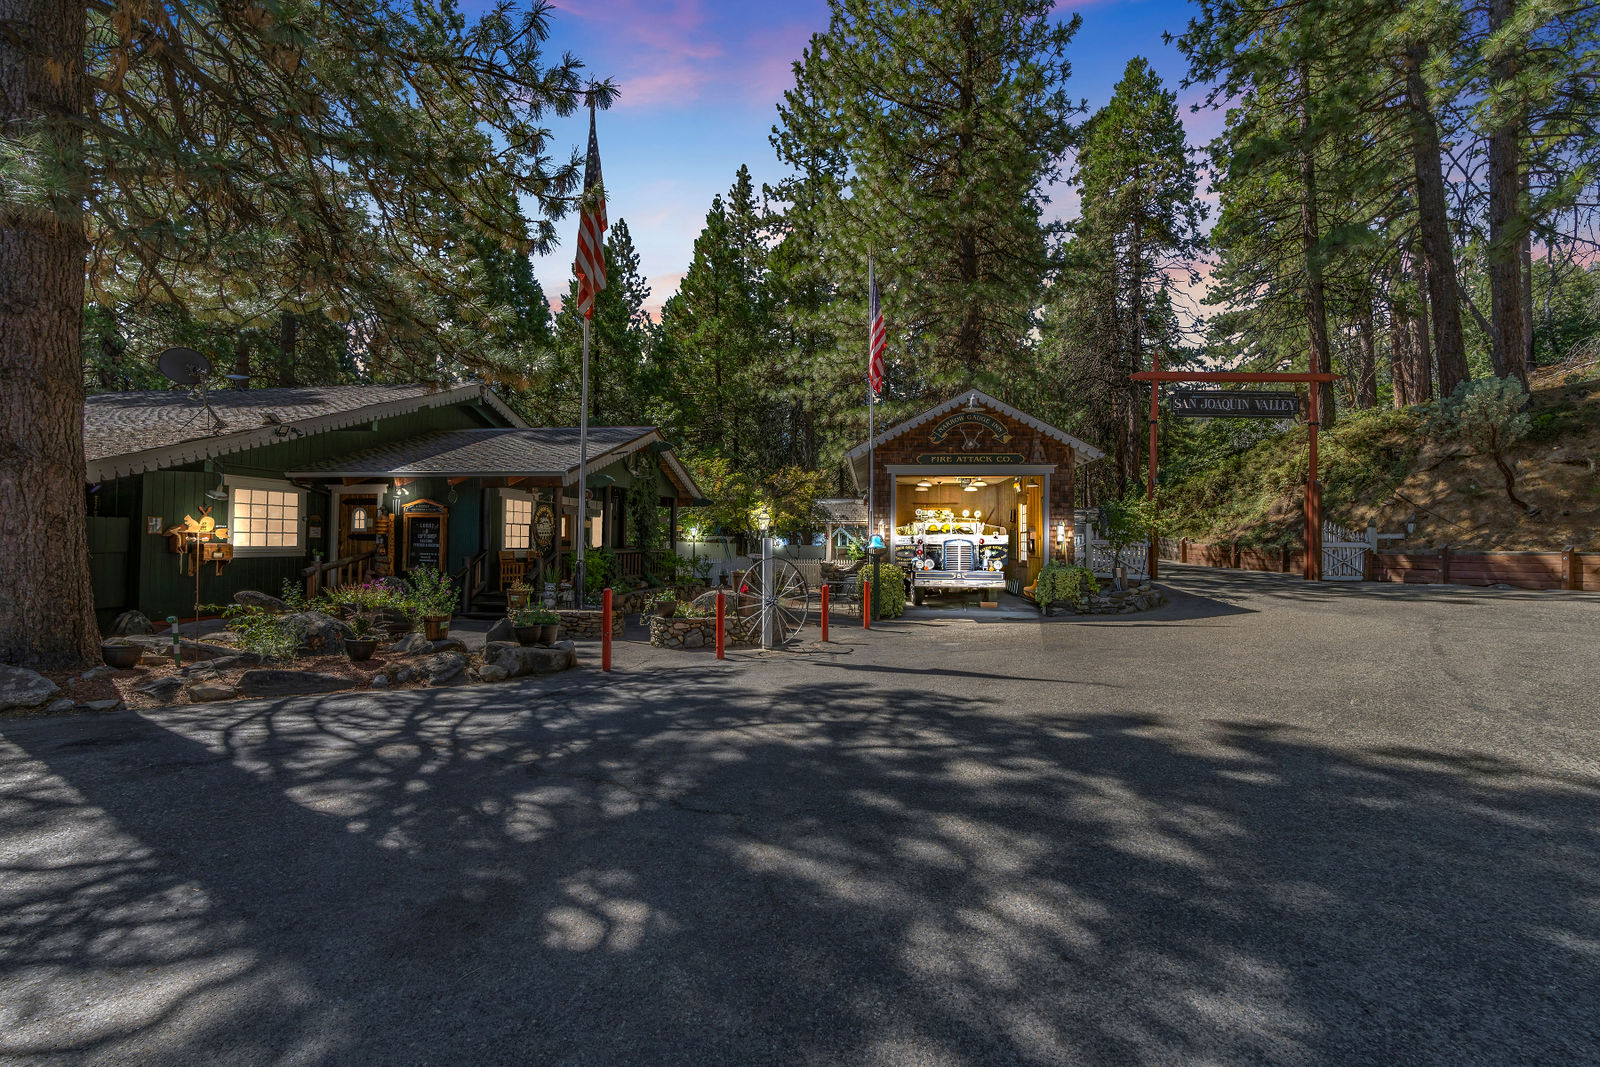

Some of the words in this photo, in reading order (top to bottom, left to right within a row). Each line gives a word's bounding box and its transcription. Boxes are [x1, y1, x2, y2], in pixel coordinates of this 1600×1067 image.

[1174, 399, 1197, 409] SAN
[1200, 399, 1249, 411] JOAQUIN
[1255, 399, 1296, 411] VALLEY
[938, 415, 965, 433] NARROW
[966, 414, 990, 424] GAUGE
[991, 422, 1003, 433] INN
[931, 455, 952, 463] FIRE
[956, 455, 992, 463] ATTACK
[996, 455, 1013, 463] CO.
